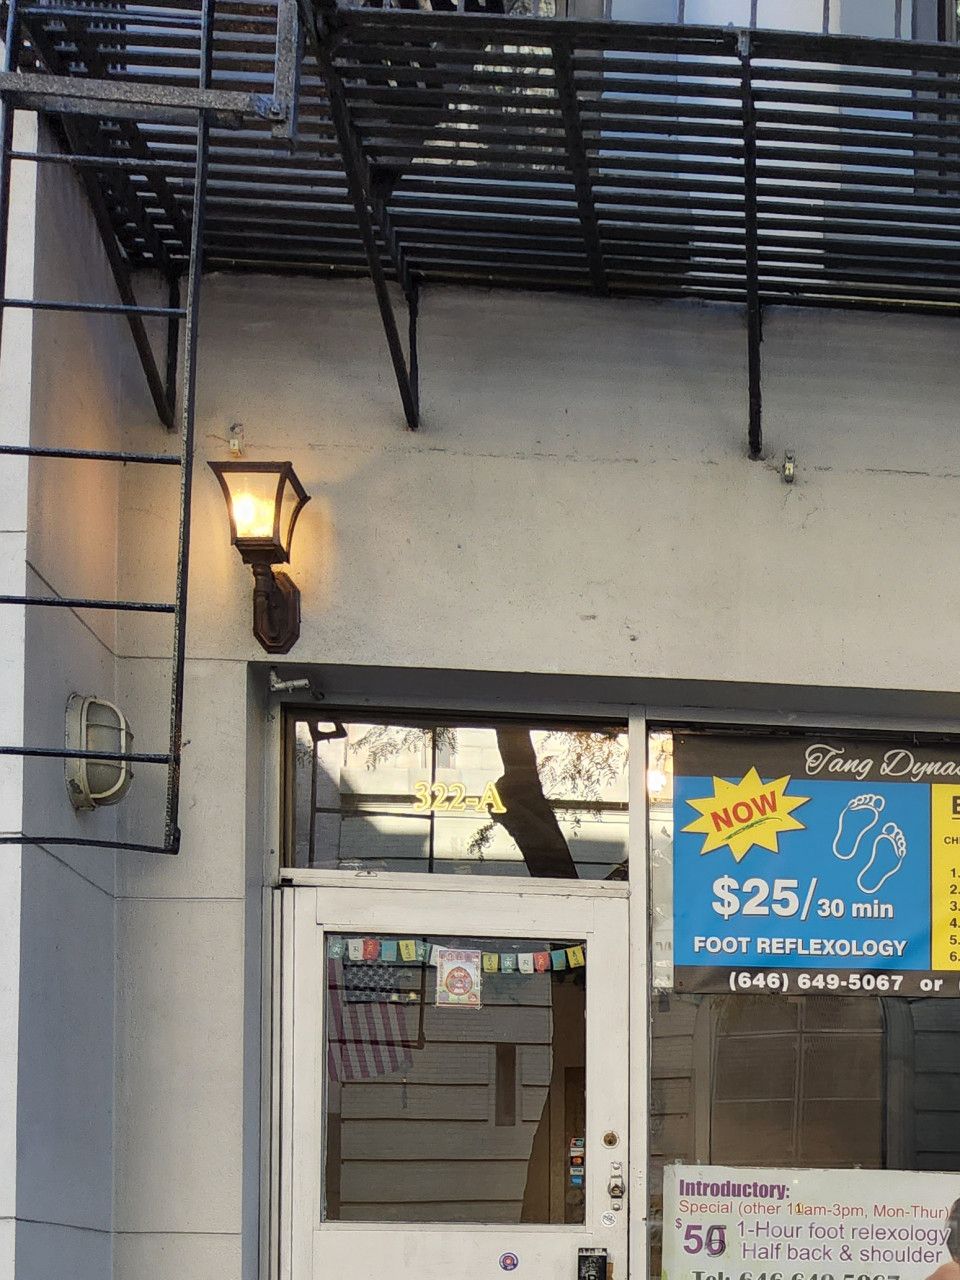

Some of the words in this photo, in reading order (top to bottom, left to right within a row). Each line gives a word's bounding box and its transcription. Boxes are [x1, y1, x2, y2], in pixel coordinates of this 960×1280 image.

[805, 743, 873, 781] Tang
[413, 781, 507, 813] 322-A
[710, 790, 778, 832] NOW
[949, 868, 960, 878] 1.
[949, 884, 960, 895] 2.
[852, 899, 894, 918] min
[949, 901, 960, 912] 3.
[949, 918, 960, 928] 4.
[694, 936, 751, 953] FOOT
[757, 937, 908, 957] REFLEXOLOGY
[949, 935, 960, 945] 5.
[949, 952, 960, 962] 6.
[729, 972, 789, 992] (646)
[798, 974, 903, 991] 649-5067
[919, 978, 943, 991] or
[680, 1180, 790, 1200] Introductory:
[679, 1200, 733, 1216] Special
[739, 1201, 781, 1217] (other
[873, 1204, 950, 1219] Mon-Thur)
[737, 1221, 803, 1239] 1-Hour
[808, 1222, 845, 1239] foot
[851, 1224, 951, 1246] relexology
[742, 1242, 782, 1260] Half
[787, 1244, 833, 1261] back
[839, 1245, 853, 1262] &
[860, 1246, 943, 1263] shoulder
